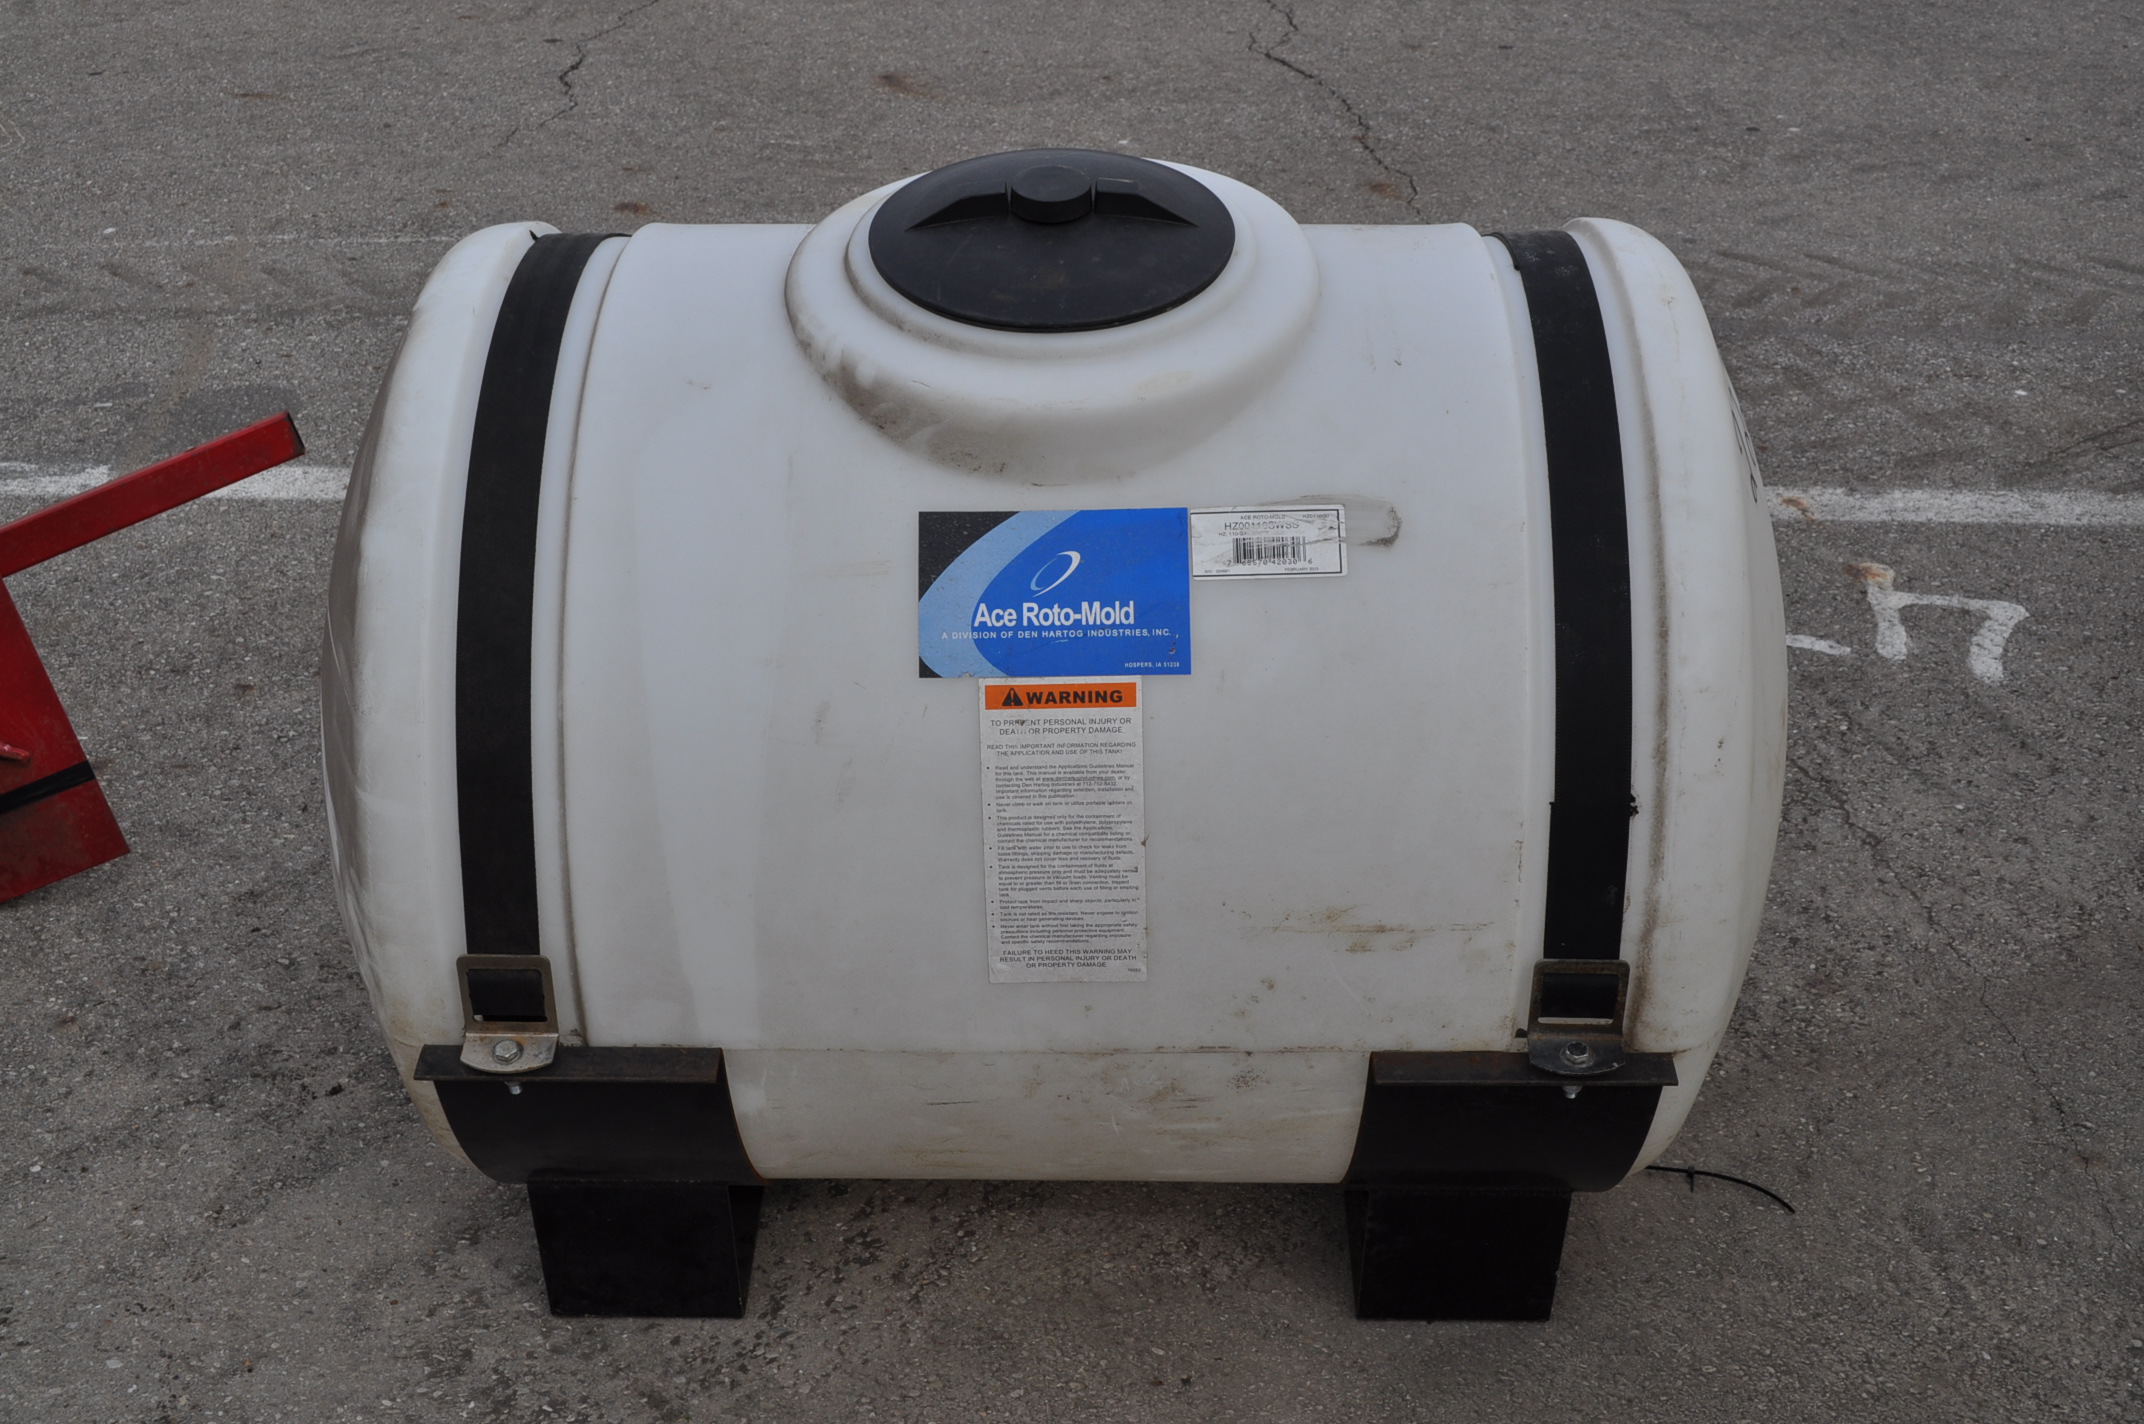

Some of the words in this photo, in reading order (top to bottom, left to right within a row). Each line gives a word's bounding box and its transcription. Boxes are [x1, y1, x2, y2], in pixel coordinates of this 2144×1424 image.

[973, 603, 1018, 627] Ace
[1022, 600, 1135, 627] Roto-Mold
[941, 632, 949, 640] A
[952, 631, 997, 640] DIVISION
[1000, 631, 1014, 639] OF
[1017, 631, 1038, 639] DEN
[1042, 630, 1084, 638] HARTOG
[1087, 628, 1150, 638] INDUSTRIES,
[1152, 628, 1172, 637] INC.
[1026, 690, 1124, 705] WARNING
[1043, 718, 1086, 726] PERSONAL
[1042, 727, 1086, 735] PROPERTY
